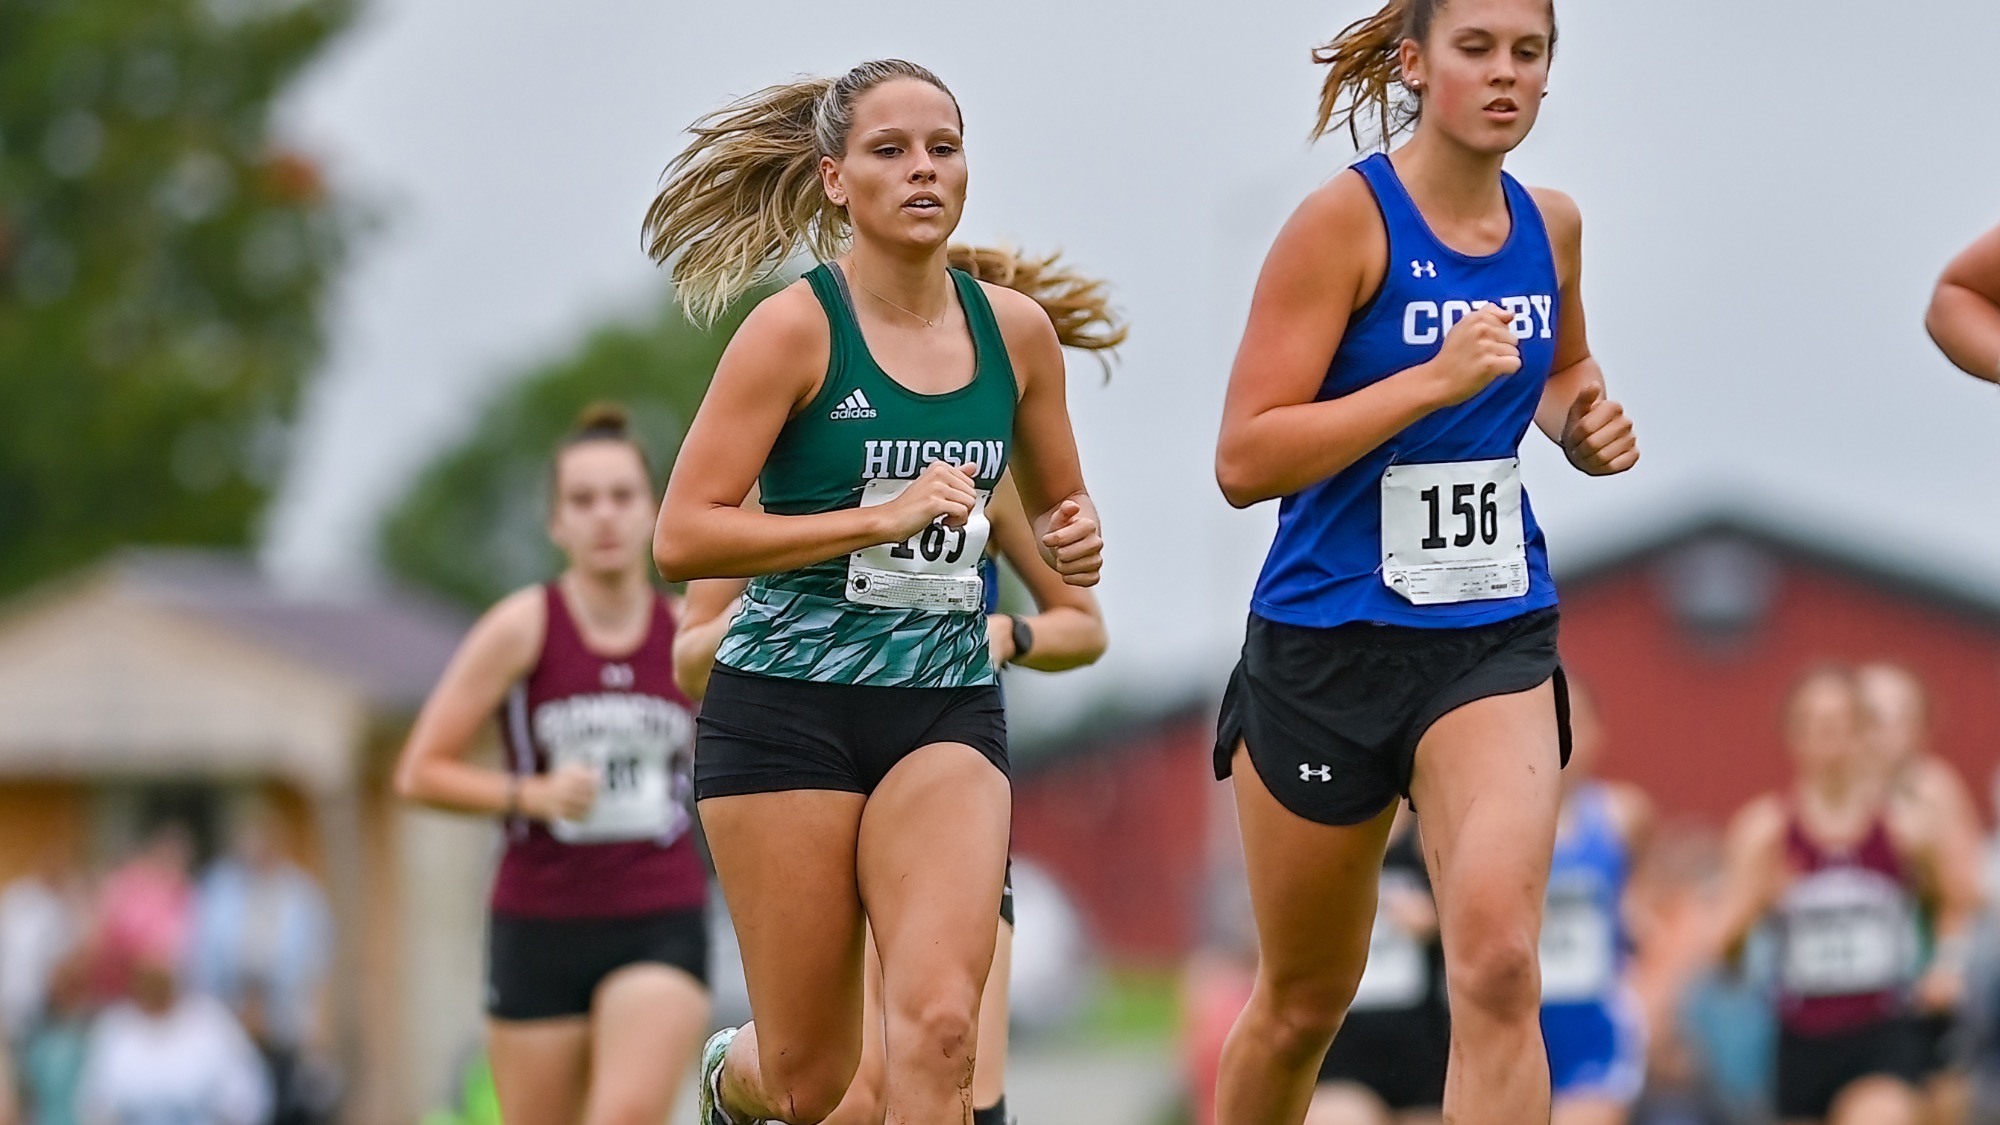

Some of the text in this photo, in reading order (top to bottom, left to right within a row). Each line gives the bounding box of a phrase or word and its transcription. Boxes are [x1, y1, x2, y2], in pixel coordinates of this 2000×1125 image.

[1403, 295, 1552, 345] COBY
[830, 407, 877, 420] adidas
[862, 440, 1004, 479] HUSSON
[1421, 482, 1498, 549] 156
